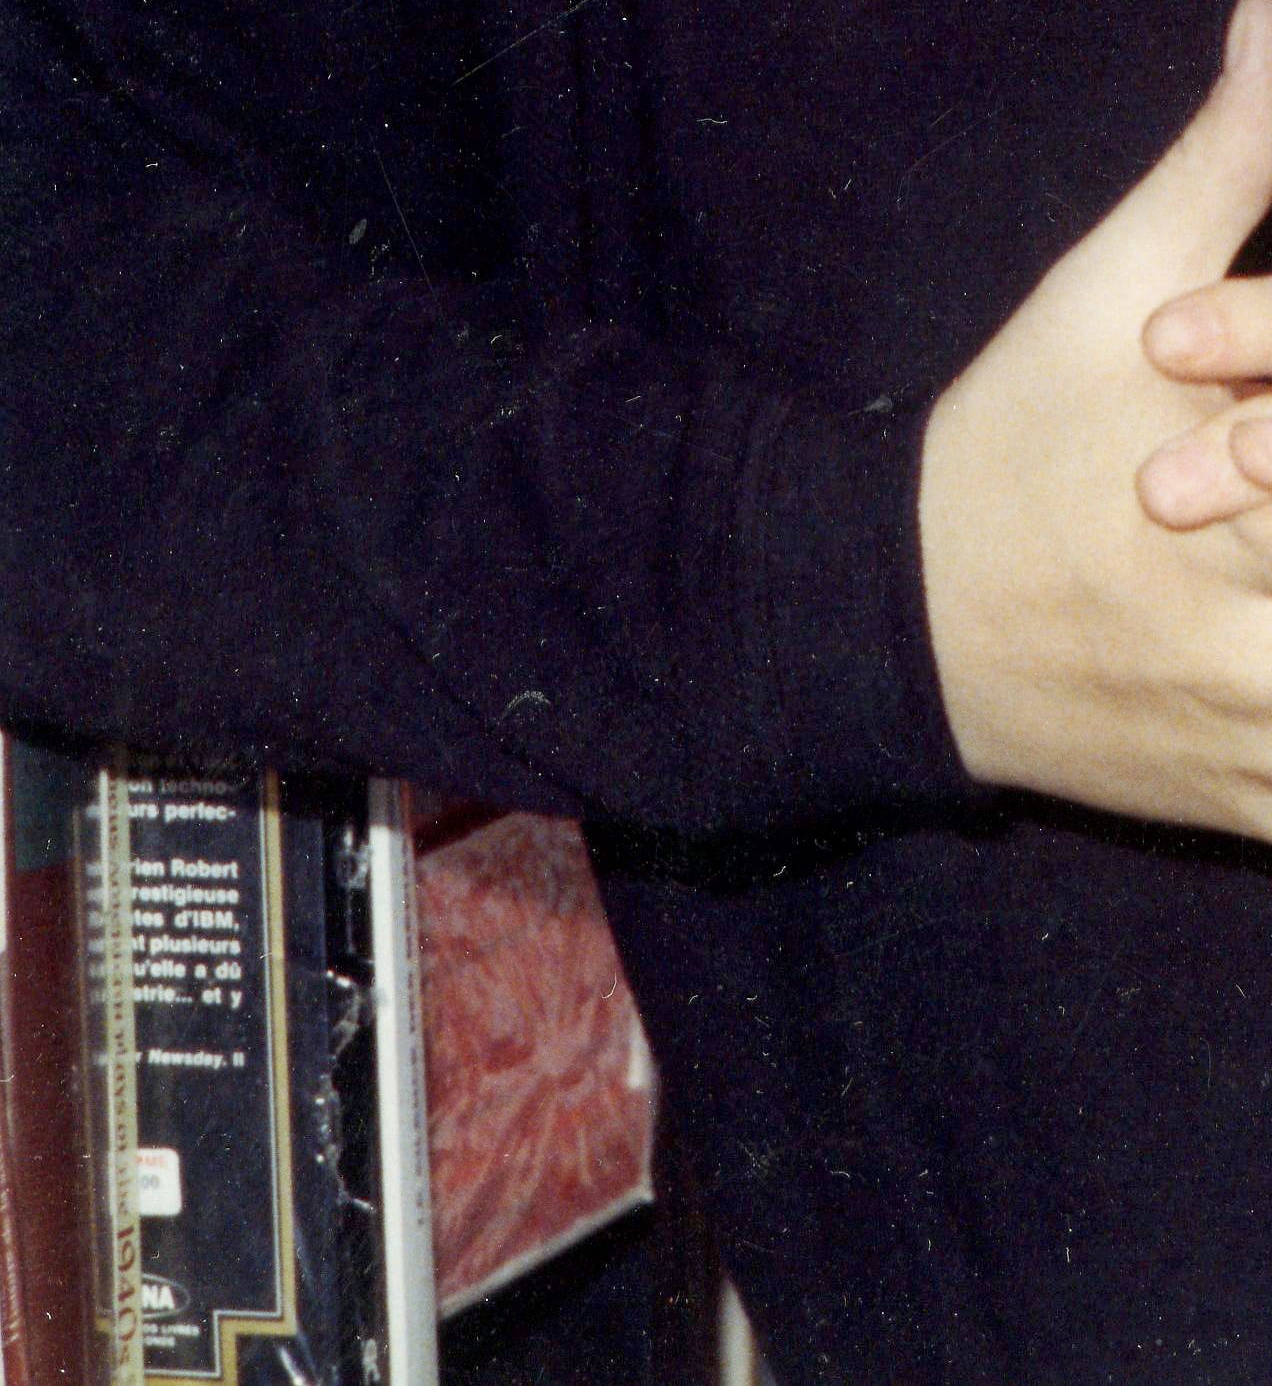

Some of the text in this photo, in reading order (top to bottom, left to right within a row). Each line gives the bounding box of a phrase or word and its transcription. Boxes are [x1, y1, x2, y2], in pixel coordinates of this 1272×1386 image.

[164, 802, 236, 824] perfec-
[171, 858, 238, 879] Robert
[174, 910, 239, 932] d'IBM,
[150, 934, 240, 956] plusieurs
[194, 963, 206, 978] a
[215, 961, 242, 979] dû
[202, 987, 221, 1004] et
[231, 990, 242, 1009] y
[148, 1049, 227, 1070] Newsday.
[116, 1223, 137, 1366] 1940s
